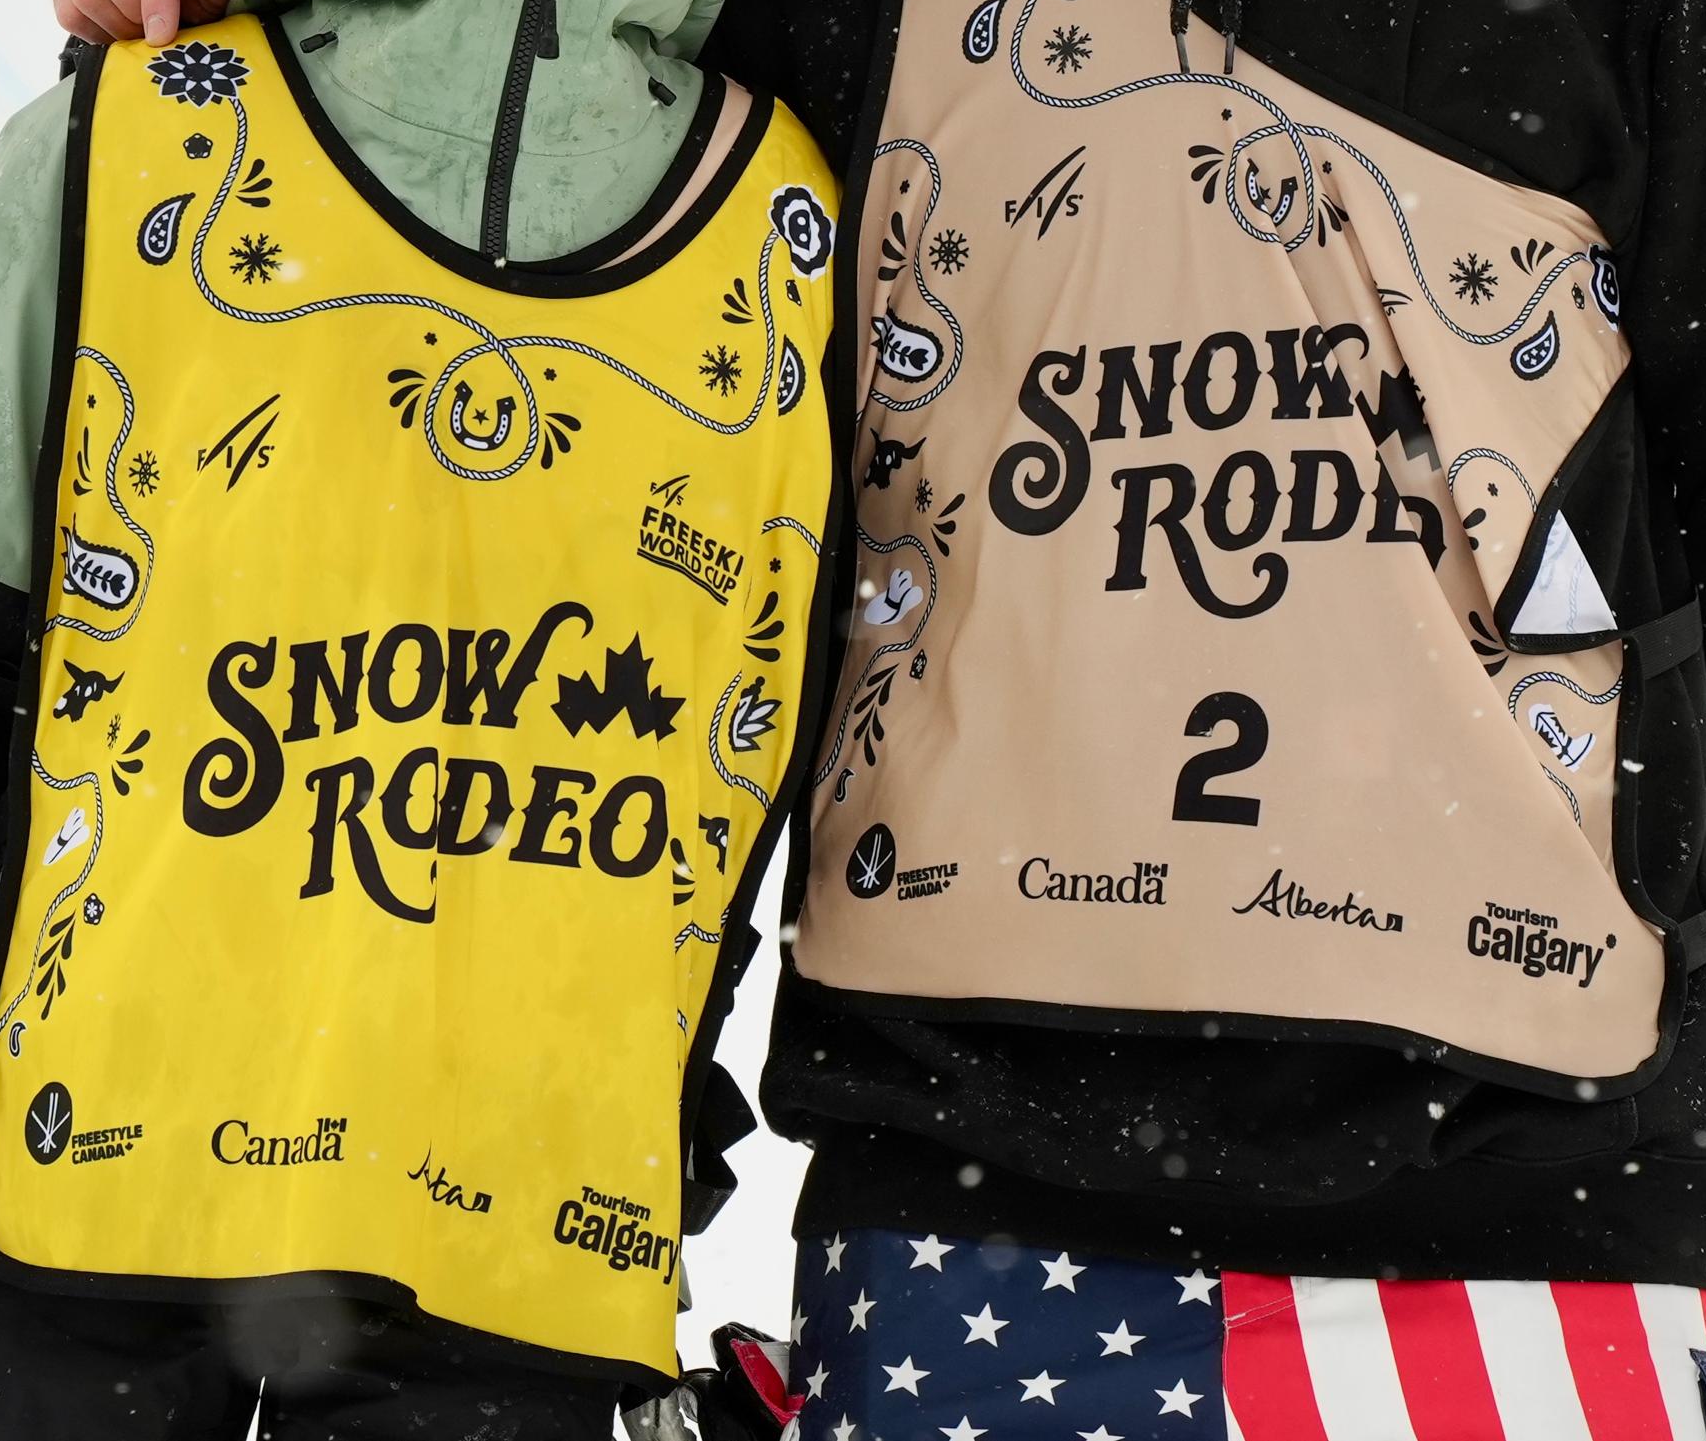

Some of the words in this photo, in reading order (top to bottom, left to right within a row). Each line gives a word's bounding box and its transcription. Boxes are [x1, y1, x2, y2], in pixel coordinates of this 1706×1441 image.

[988, 323, 1370, 537] SNOW
[639, 528, 702, 574] WORLD
[705, 565, 738, 594] CUP
[641, 505, 745, 577] FREESKI
[183, 601, 595, 839] SNOW
[1172, 690, 1271, 827] 2
[299, 746, 670, 925] RODEO
[896, 862, 959, 887] FREESTYLE
[897, 879, 944, 902] CANADA
[1017, 857, 1168, 906] Canada
[1231, 868, 1396, 932] Alberta
[1485, 901, 1559, 930] Tourism
[1467, 915, 1604, 989] Calgary
[71, 1124, 144, 1150] FREESTYLE
[71, 1143, 126, 1164] CANADA
[211, 1116, 345, 1167] Canada
[582, 1185, 651, 1222] Tourism
[553, 1199, 679, 1286] Calgary
